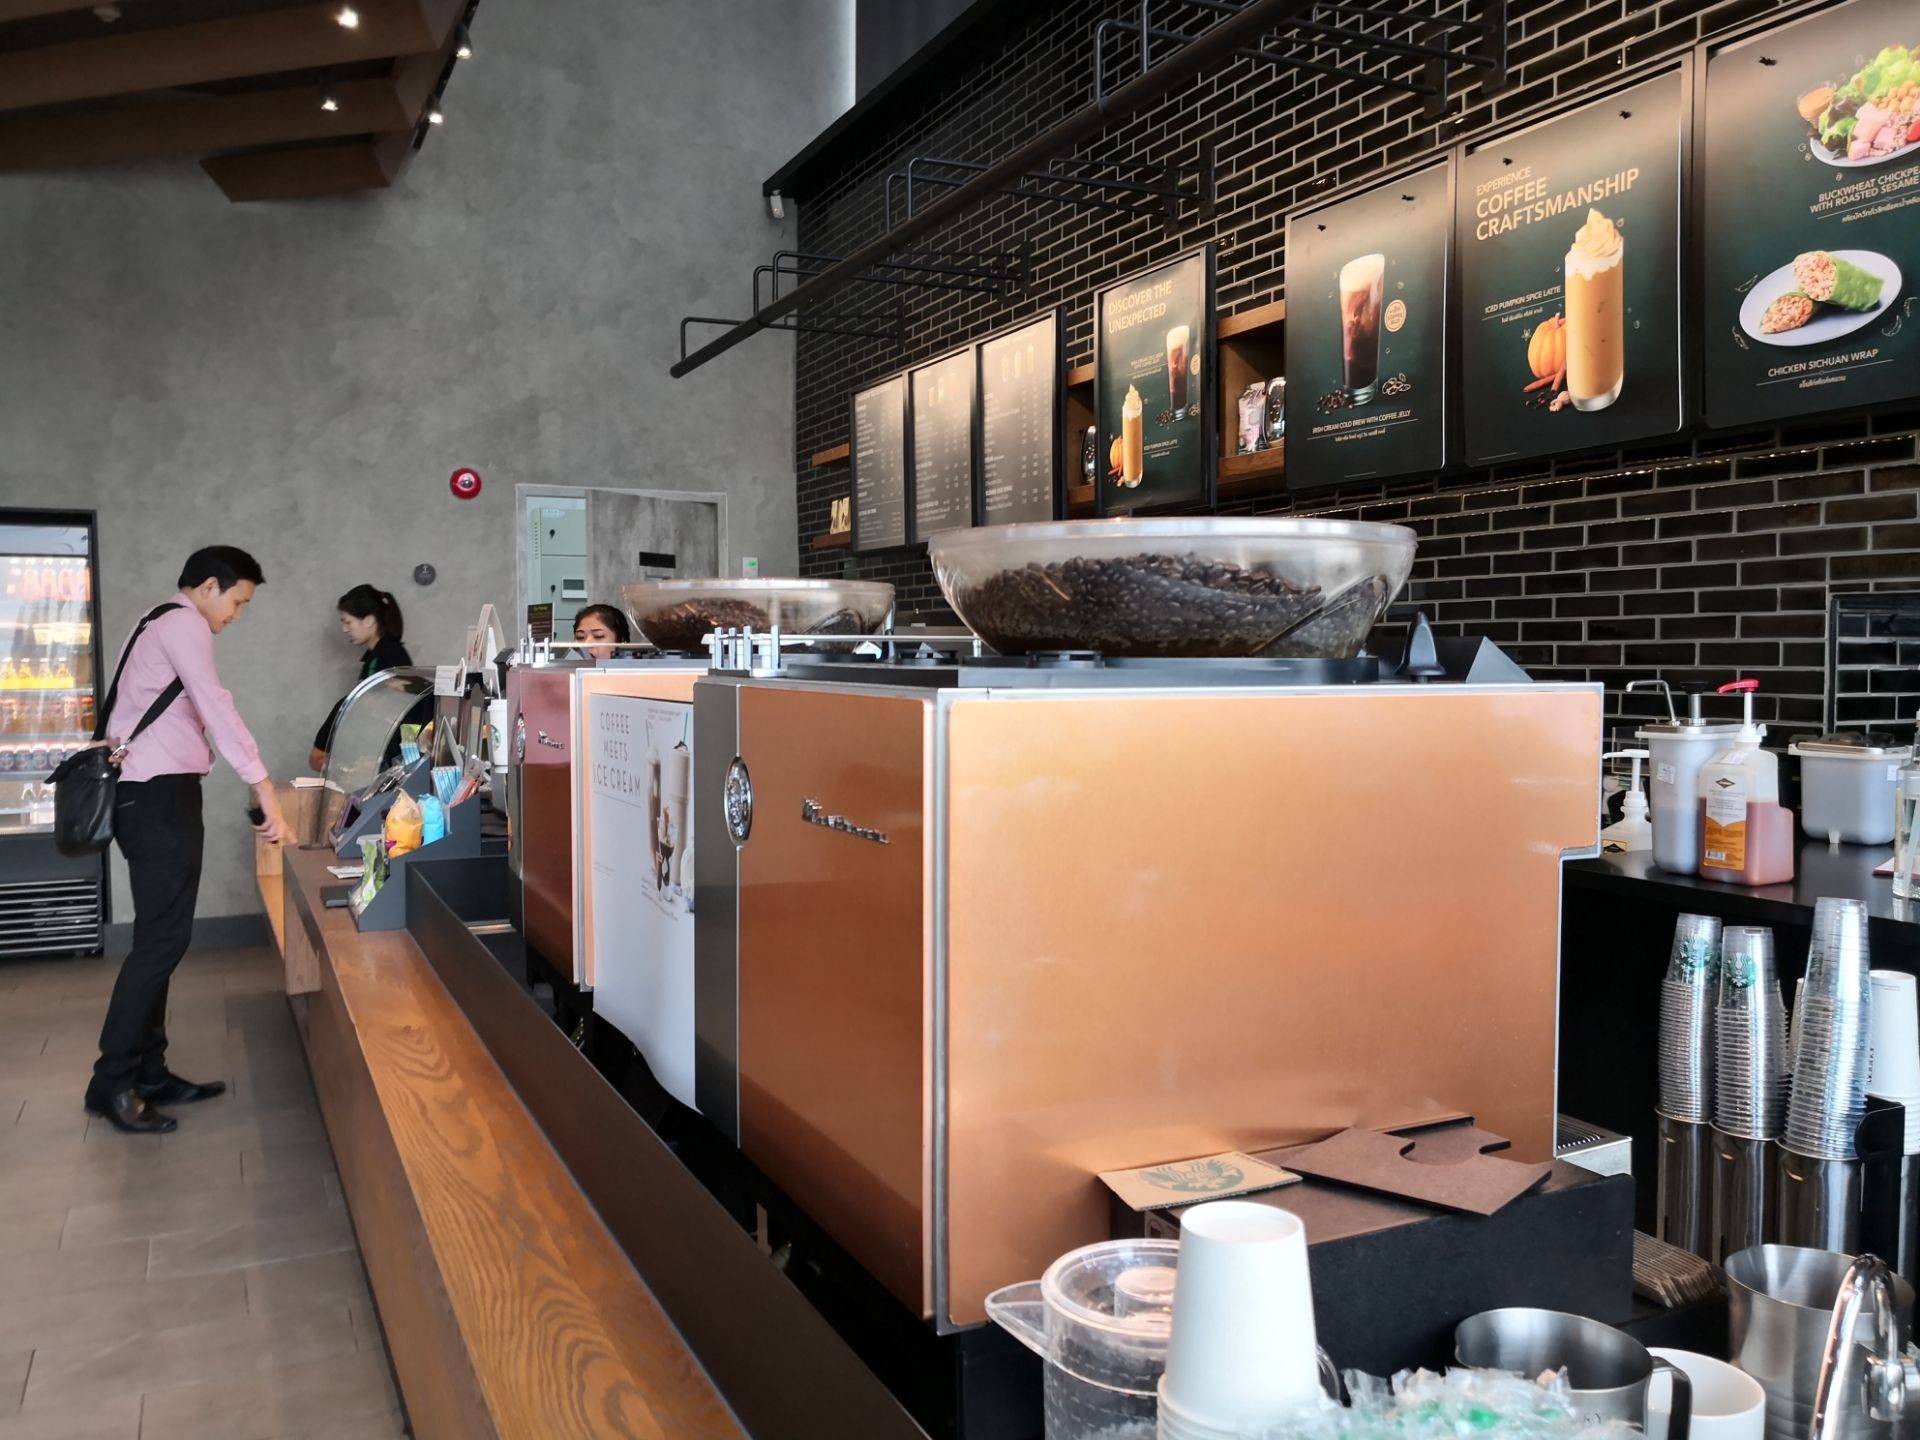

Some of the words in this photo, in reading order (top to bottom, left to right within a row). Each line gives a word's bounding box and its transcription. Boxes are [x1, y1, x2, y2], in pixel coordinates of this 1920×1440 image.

[1476, 166, 1532, 196] EXPERIENCE
[1809, 200, 1833, 213] WITH
[1835, 187, 1878, 207] ROASTED
[1880, 175, 1920, 194] SESAME
[1818, 178, 1876, 202] BUCKWHEAT
[1877, 165, 1920, 185] CHICKPE
[1476, 177, 1547, 219] COFFEE
[1476, 167, 1640, 241] CRAFTSMANSHIP
[1108, 288, 1152, 316] DISCOVER
[1153, 280, 1173, 299] THE
[1485, 303, 1498, 314] ICED
[1498, 296, 1525, 310] PUMPKIN
[1526, 290, 1542, 302] SPICE
[1543, 285, 1561, 297] LATTE
[1108, 302, 1167, 334] UNEXPECTED
[1767, 362, 1806, 377] CHICKEN
[1808, 355, 1848, 370] SICHUAN
[1851, 348, 1879, 361] WRAP
[1379, 412, 1397, 422] COFFEE
[600, 712, 630, 735] COFFEE
[603, 739, 628, 762] MEETS
[610, 767, 641, 797] CREAM
